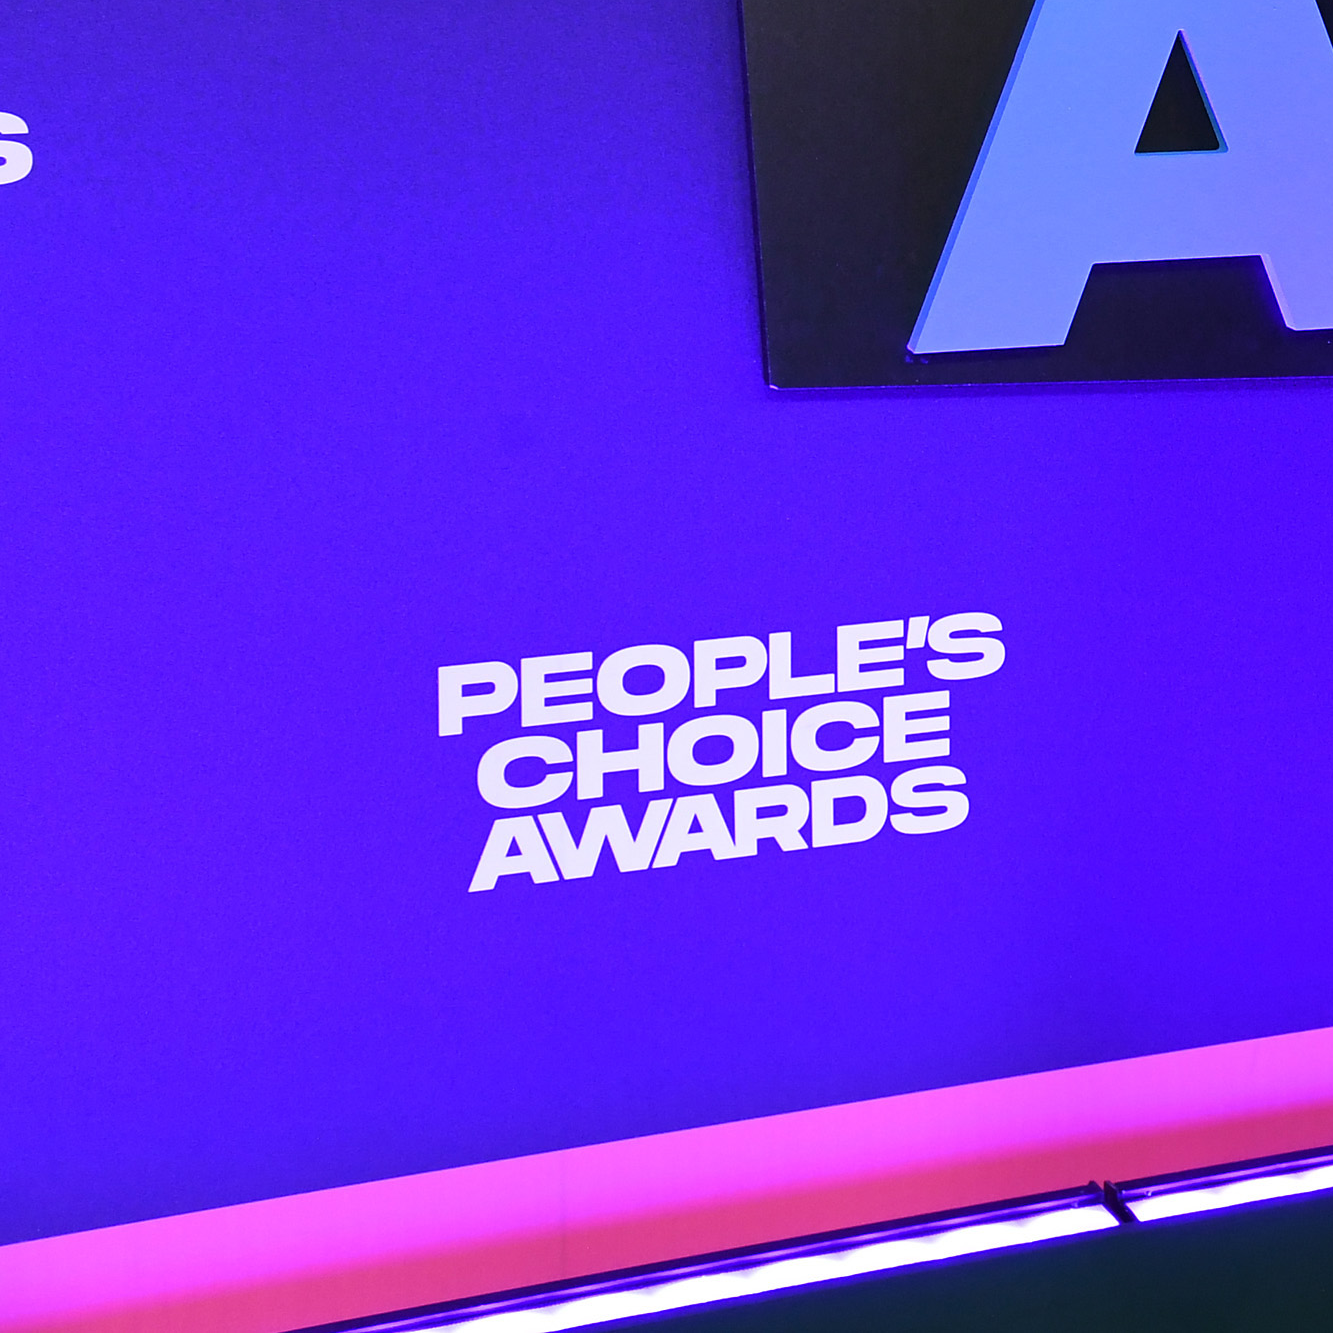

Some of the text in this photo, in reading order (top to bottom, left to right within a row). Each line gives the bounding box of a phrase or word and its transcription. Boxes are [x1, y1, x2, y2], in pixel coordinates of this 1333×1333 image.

[438, 612, 1006, 737] PEOPLE'S
[477, 689, 951, 809] CHOICE
[468, 765, 970, 893] AWARDS
